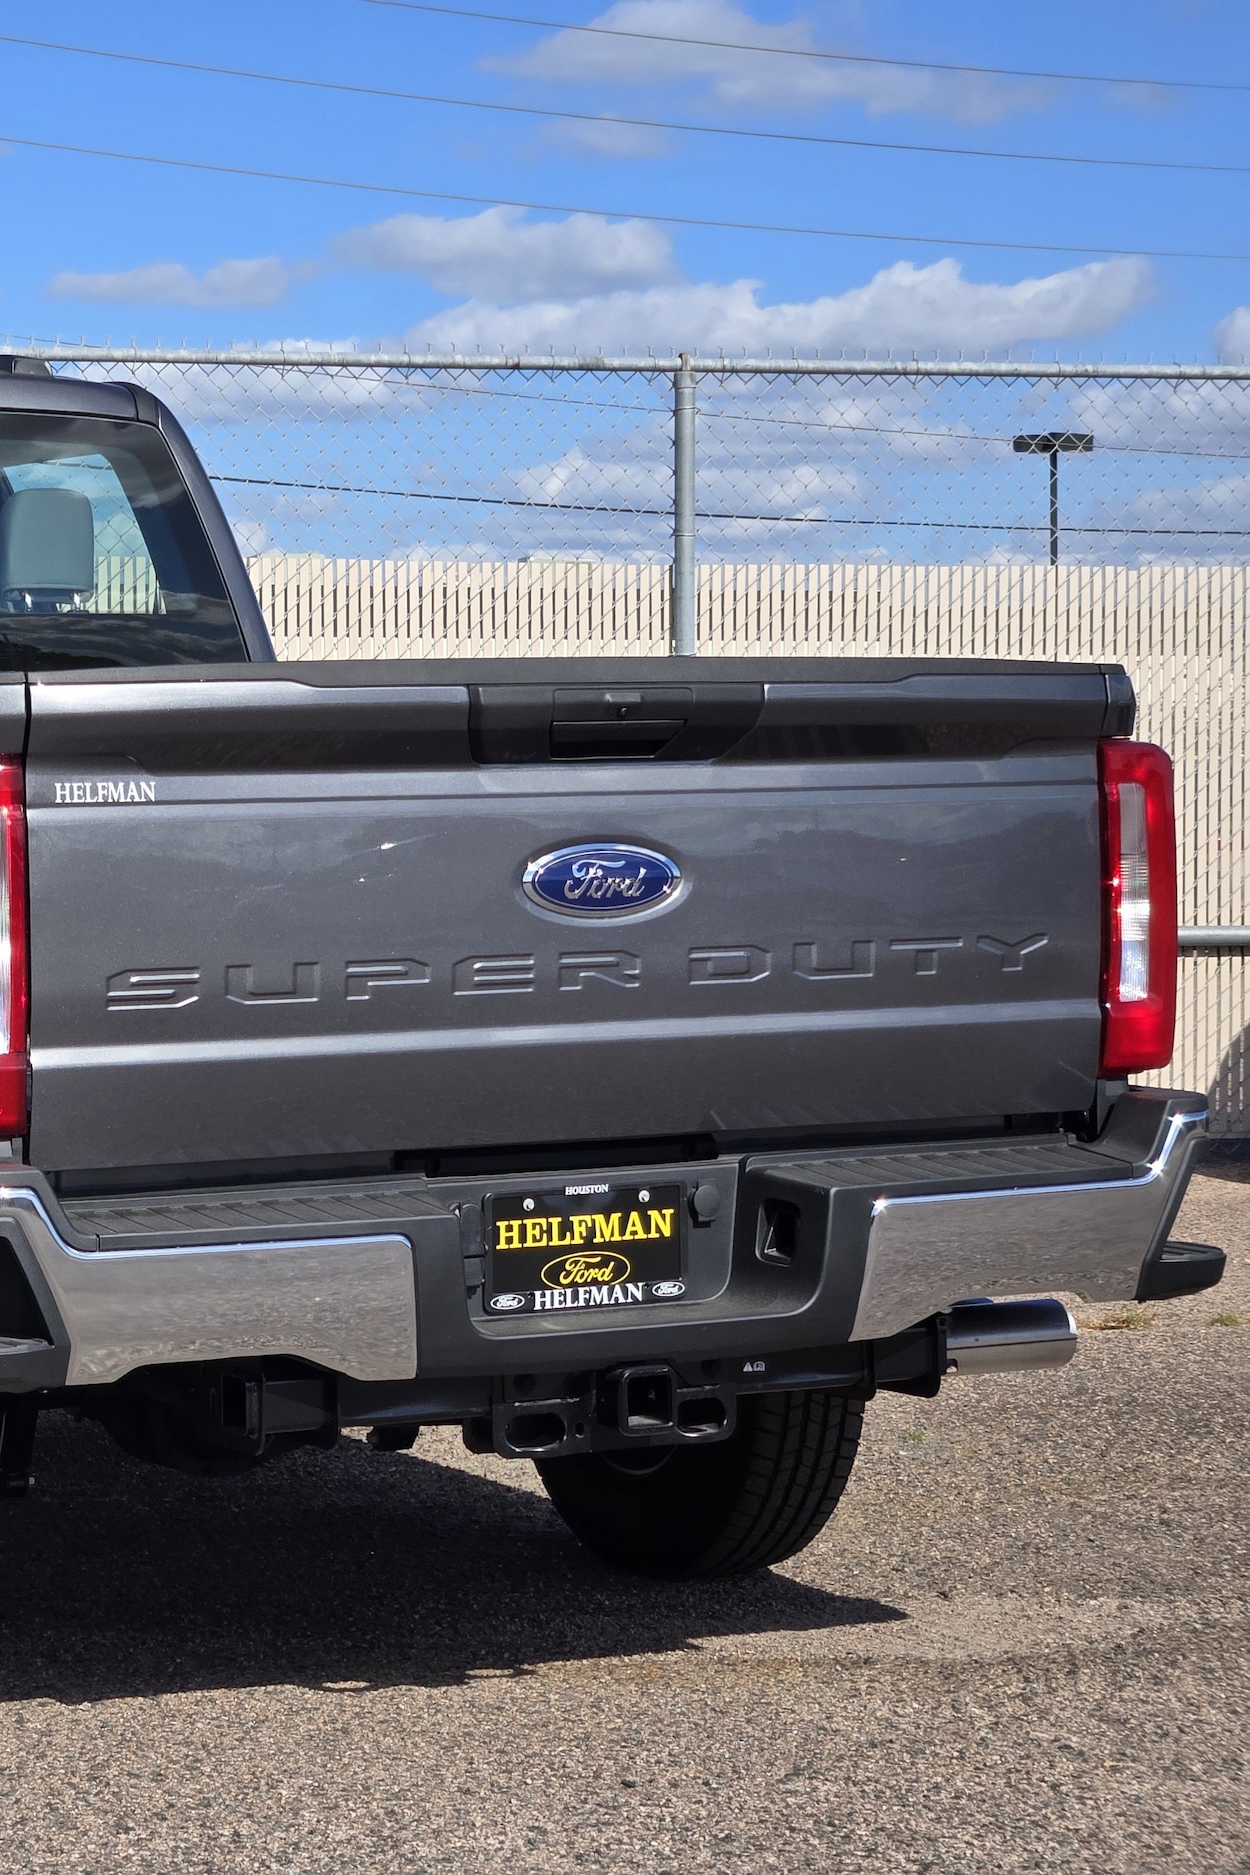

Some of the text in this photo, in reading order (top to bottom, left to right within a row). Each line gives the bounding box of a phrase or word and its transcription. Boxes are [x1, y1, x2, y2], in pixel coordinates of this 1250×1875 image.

[54, 781, 156, 803] HELFMAN
[563, 859, 645, 900] Ford
[106, 933, 1049, 1011] SUPER DUTY
[565, 1184, 609, 1196] HOUSTON
[495, 1208, 675, 1250] HELFMAN
[559, 1256, 615, 1285] Ford
[533, 1282, 645, 1311] HELFMAN
